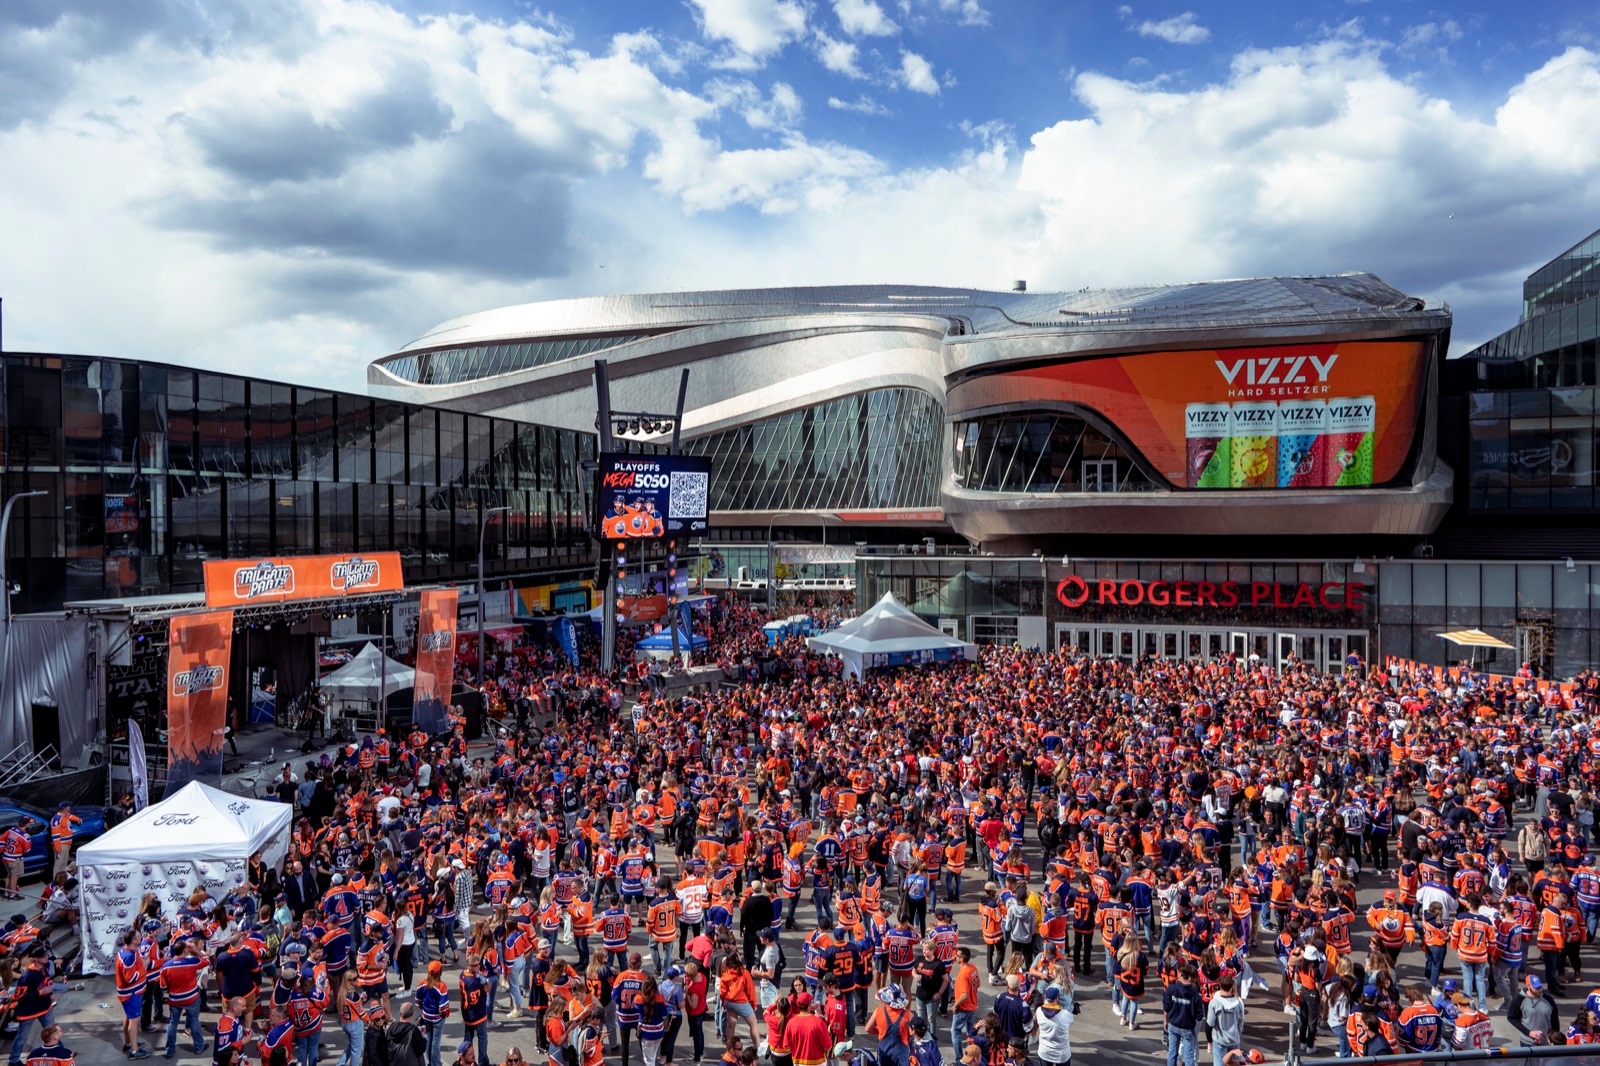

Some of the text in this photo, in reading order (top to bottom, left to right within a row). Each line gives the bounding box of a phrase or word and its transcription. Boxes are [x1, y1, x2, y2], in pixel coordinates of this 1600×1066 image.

[1215, 354, 1339, 385] VIZZY
[1228, 385, 1329, 397] HARD SELTZER
[1188, 411, 1228, 422] VIZZY
[1234, 410, 1276, 422] VIZZY
[1281, 408, 1324, 420] VIZZY
[1330, 405, 1372, 418] VIZZY
[614, 463, 660, 472] PLAYOFFS
[603, 472, 669, 488] MEGA 5050
[239, 566, 290, 586] TAILGATE
[334, 562, 376, 578] TAILGATE
[250, 574, 288, 597] PARTY
[345, 571, 373, 588] PARTY
[1100, 580, 1364, 608] ROGERS PLACE
[568, 624, 578, 649] CHED
[228, 801, 250, 816] Ford
[153, 813, 200, 827] Ford
[1347, 815, 1360, 828] 14
[825, 844, 835, 856] 11
[225, 862, 246, 872] Ford
[772, 853, 783, 870] 18
[106, 870, 131, 880] Ford
[168, 866, 192, 876] Ford
[625, 864, 643, 880] 99
[84, 884, 107, 894] Ford
[144, 880, 168, 890] Ford
[202, 879, 225, 888] Ford
[556, 884, 572, 898] 97
[1466, 880, 1482, 894] 97
[1581, 880, 1599, 896] 93
[107, 897, 132, 906] Ford
[491, 886, 510, 902] 97
[685, 893, 702, 910] 29
[335, 900, 347, 916] 4
[405, 899, 424, 917] 97
[1074, 902, 1090, 922] 97
[658, 908, 675, 928] 97
[106, 924, 130, 934] Ford
[605, 922, 625, 940] 97
[1332, 924, 1350, 941] 97
[1462, 928, 1485, 947] 97
[106, 953, 116, 962] Fo
[889, 944, 910, 962] 97
[937, 941, 954, 960] 77
[88, 963, 112, 972] Ford
[808, 954, 820, 968] 14
[832, 958, 853, 976] 29
[468, 990, 480, 1005] 97
[293, 1010, 312, 1028] 14
[218, 1034, 230, 1046] 97
[1414, 1024, 1438, 1046] 97
[1472, 1032, 1492, 1050] 93
